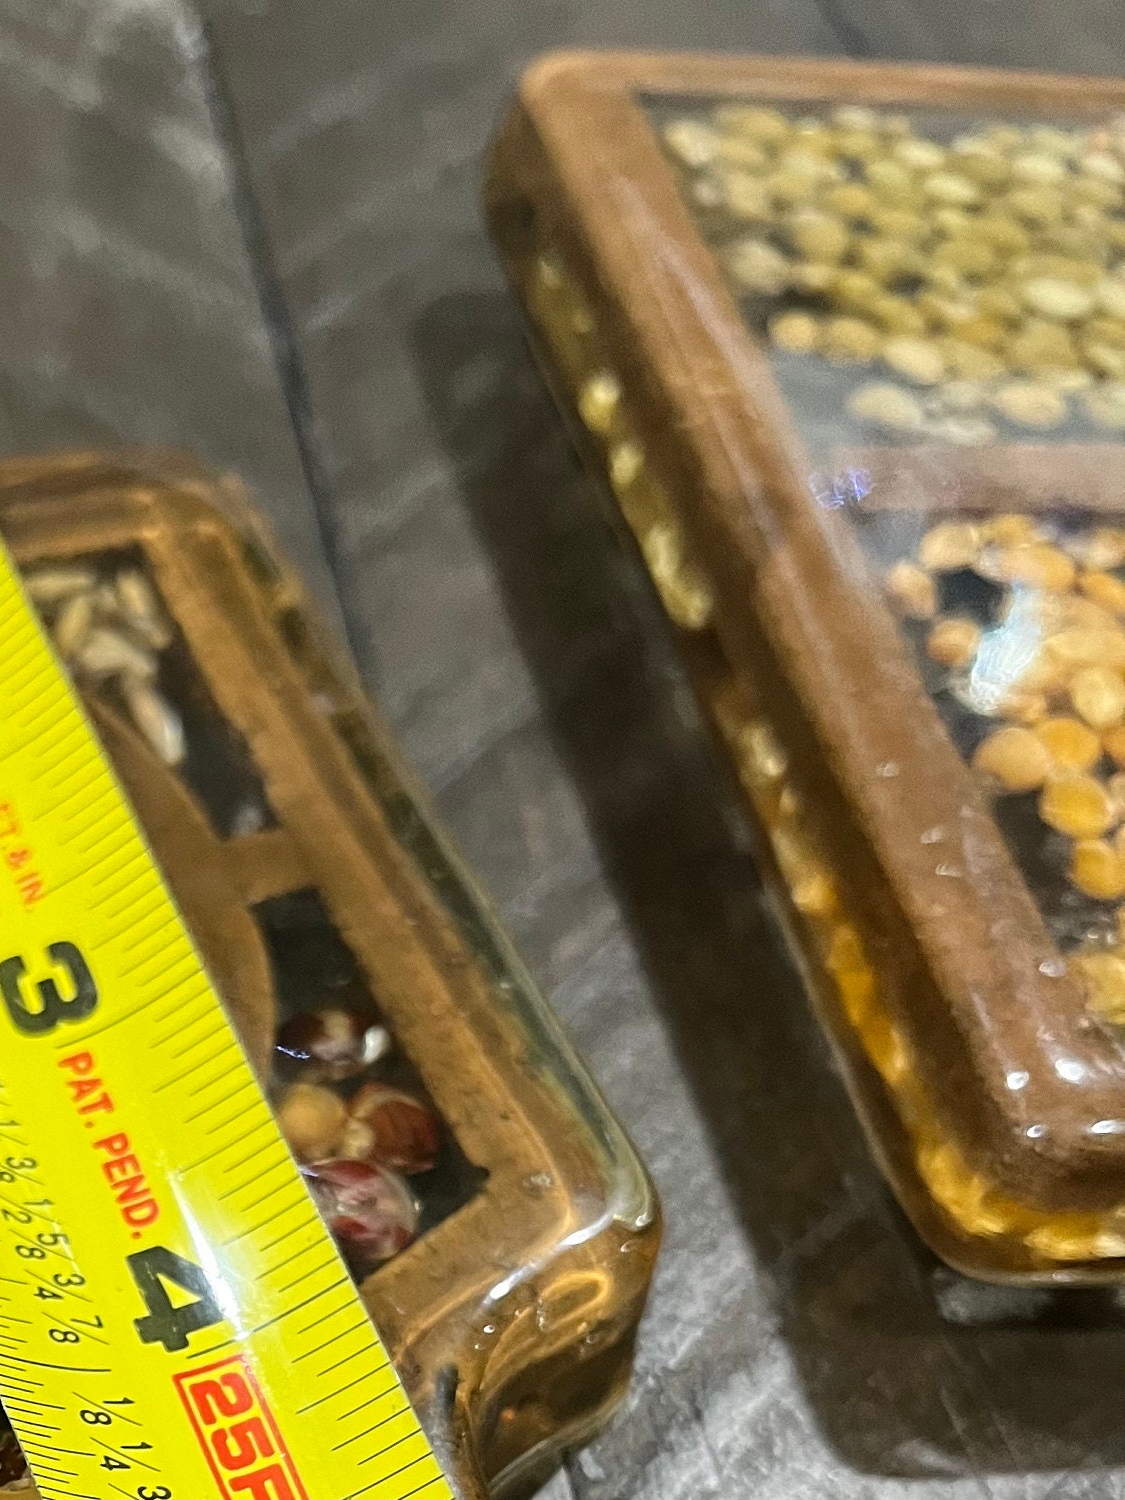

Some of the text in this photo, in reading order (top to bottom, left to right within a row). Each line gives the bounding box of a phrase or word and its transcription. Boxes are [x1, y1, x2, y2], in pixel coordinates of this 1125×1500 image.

[57, 1051, 161, 1240] PAT. PEND.
[127, 1246, 227, 1353] 4
